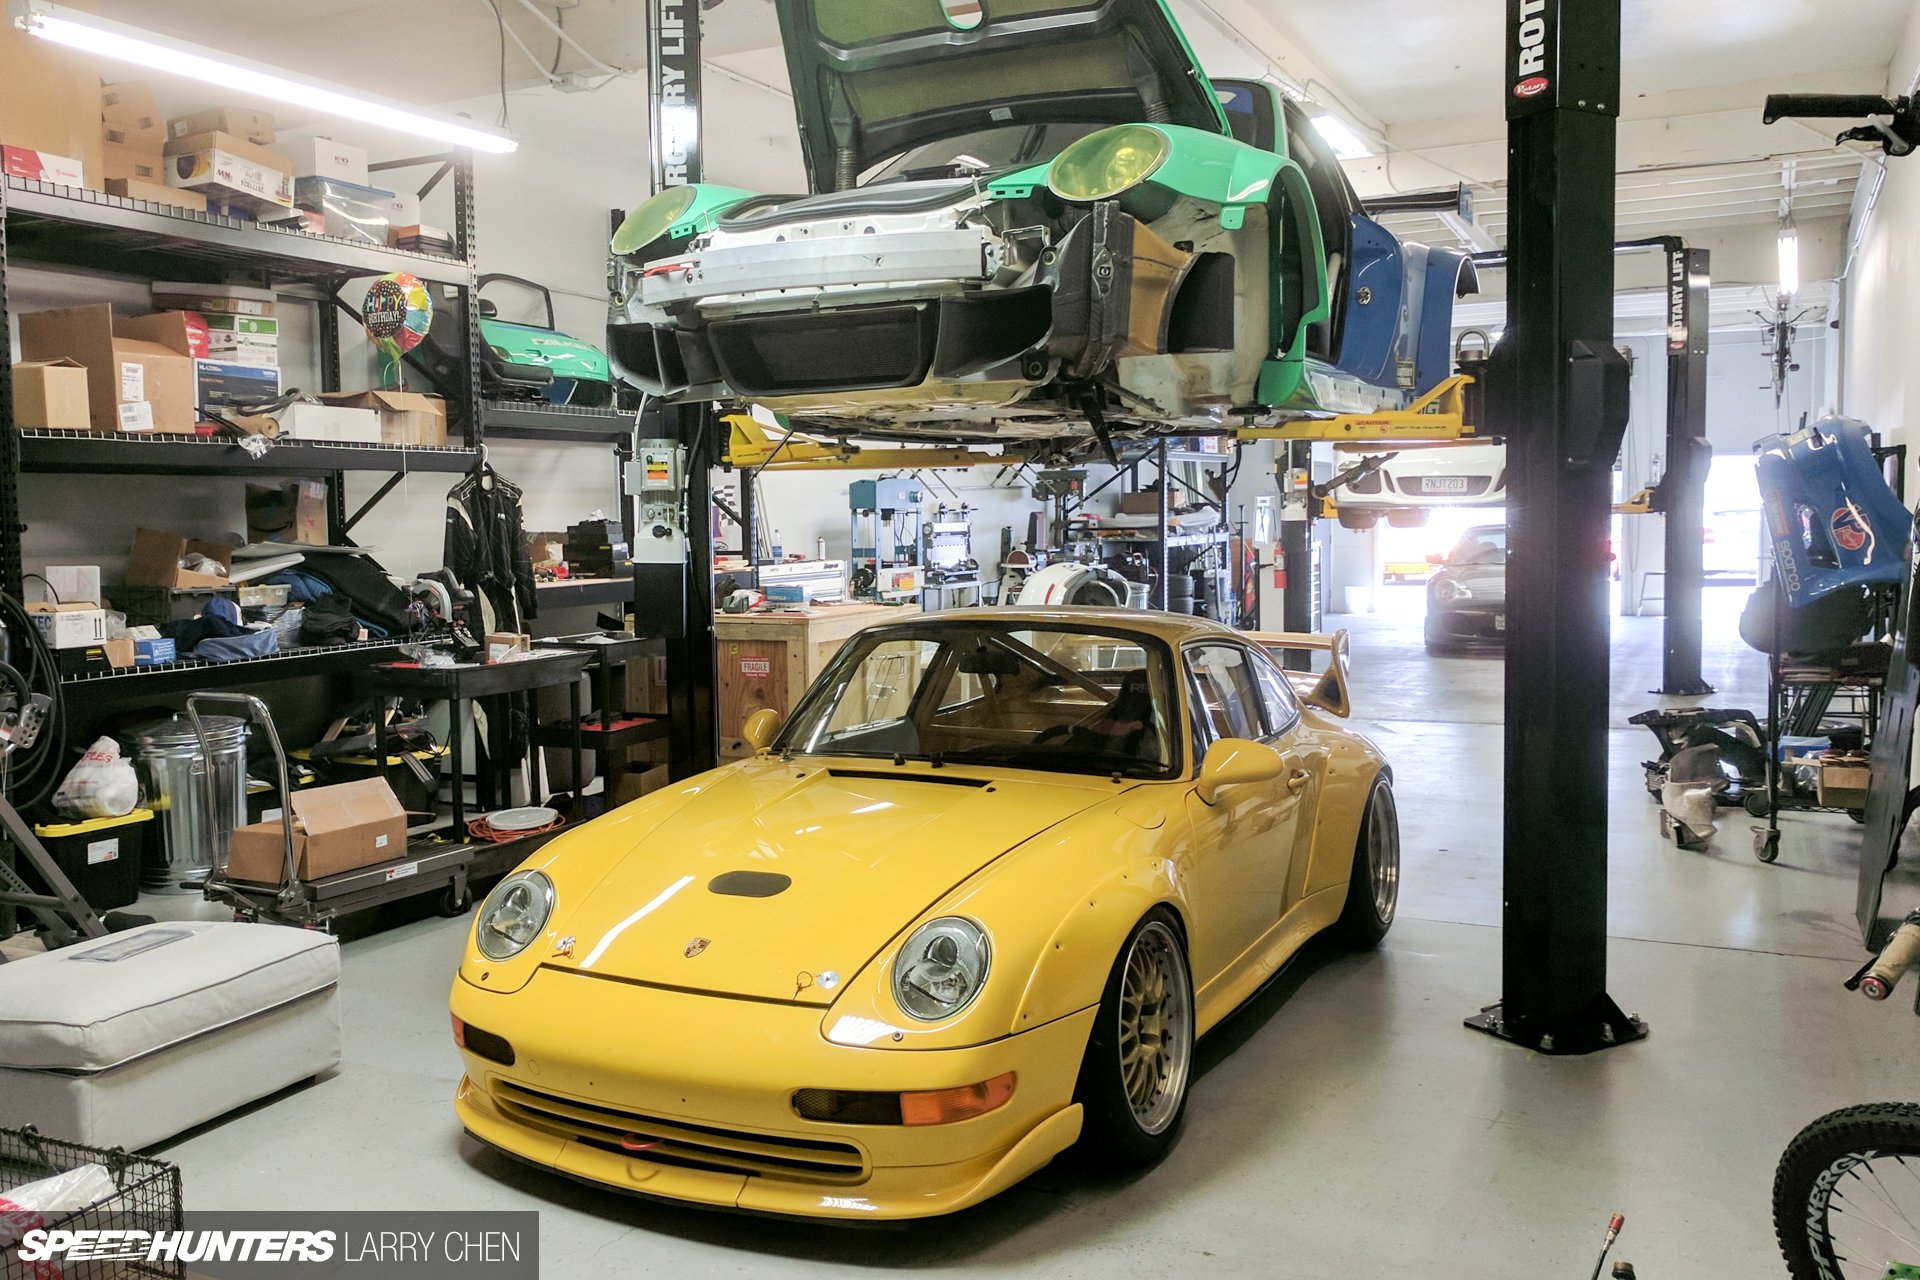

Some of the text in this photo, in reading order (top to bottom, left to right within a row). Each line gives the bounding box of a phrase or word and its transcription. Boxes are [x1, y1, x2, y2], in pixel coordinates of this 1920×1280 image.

[1517, 82, 1546, 94] Rotary
[662, 65, 687, 186] RORY
[1672, 251, 1684, 281] LIFT
[366, 294, 402, 312] HAPPY
[368, 310, 400, 324] BIRTHDAY!
[743, 662, 768, 672] FRAGILE
